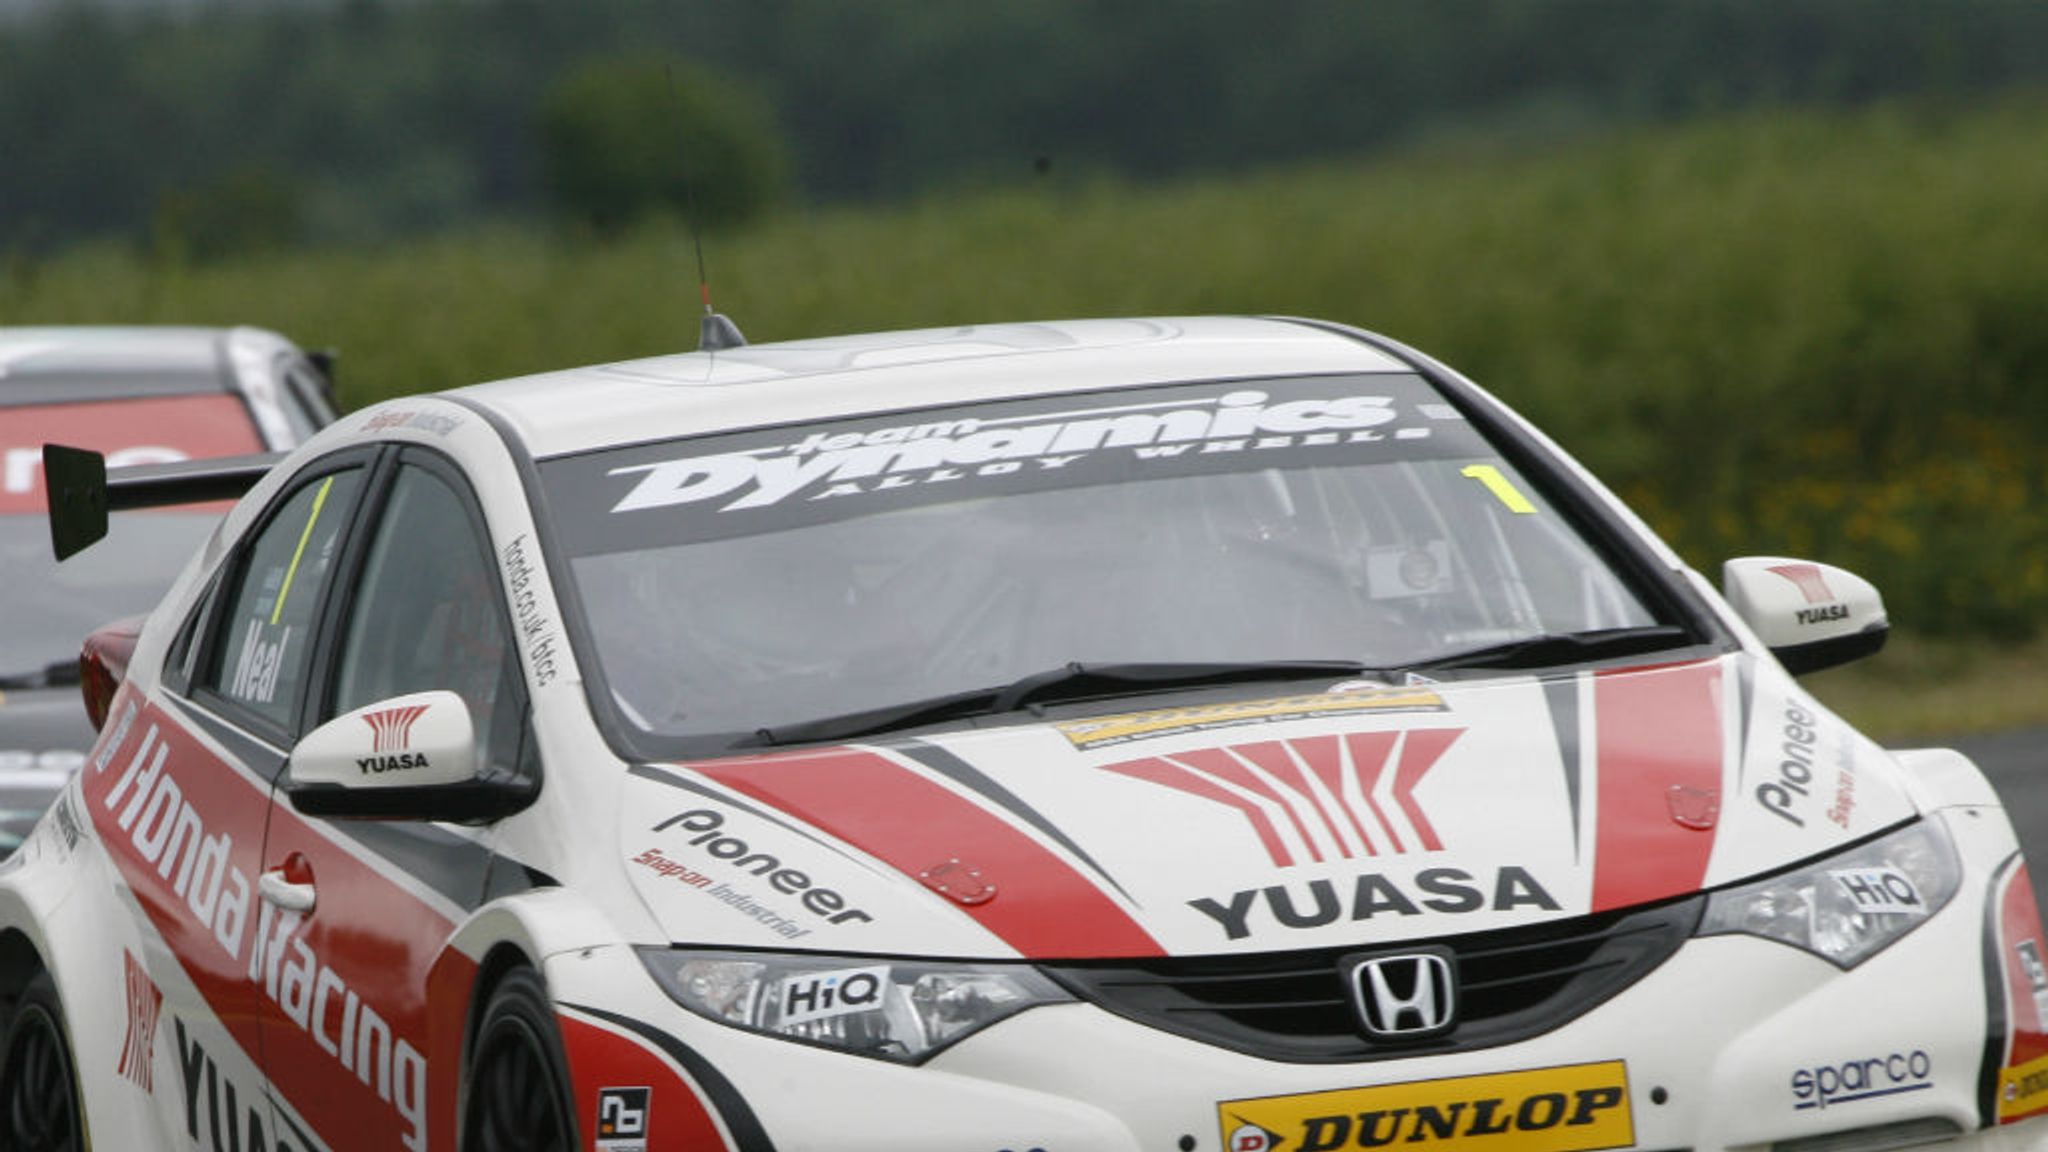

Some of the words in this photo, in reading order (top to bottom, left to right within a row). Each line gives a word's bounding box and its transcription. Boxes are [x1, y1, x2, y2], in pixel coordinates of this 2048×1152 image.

[607, 390, 1397, 513] Dynamics
[787, 417, 982, 456] team
[808, 452, 1088, 501] ALLOY
[1135, 428, 1431, 460] WHEELS
[1460, 464, 1538, 514] 1
[1795, 603, 1850, 625] YUASA
[231, 617, 291, 703] Neal
[356, 751, 430, 775] YUASA
[651, 808, 874, 925] Pioneer
[1840, 872, 1921, 905] HiQ
[707, 883, 813, 940] Industrial
[1186, 866, 1564, 941] YUASA
[104, 722, 249, 961] Honda
[247, 898, 428, 1152] Racing
[786, 972, 879, 1017] HiQ
[1792, 1050, 1931, 1110] sparco
[1293, 1085, 1624, 1152] DUNLOP
